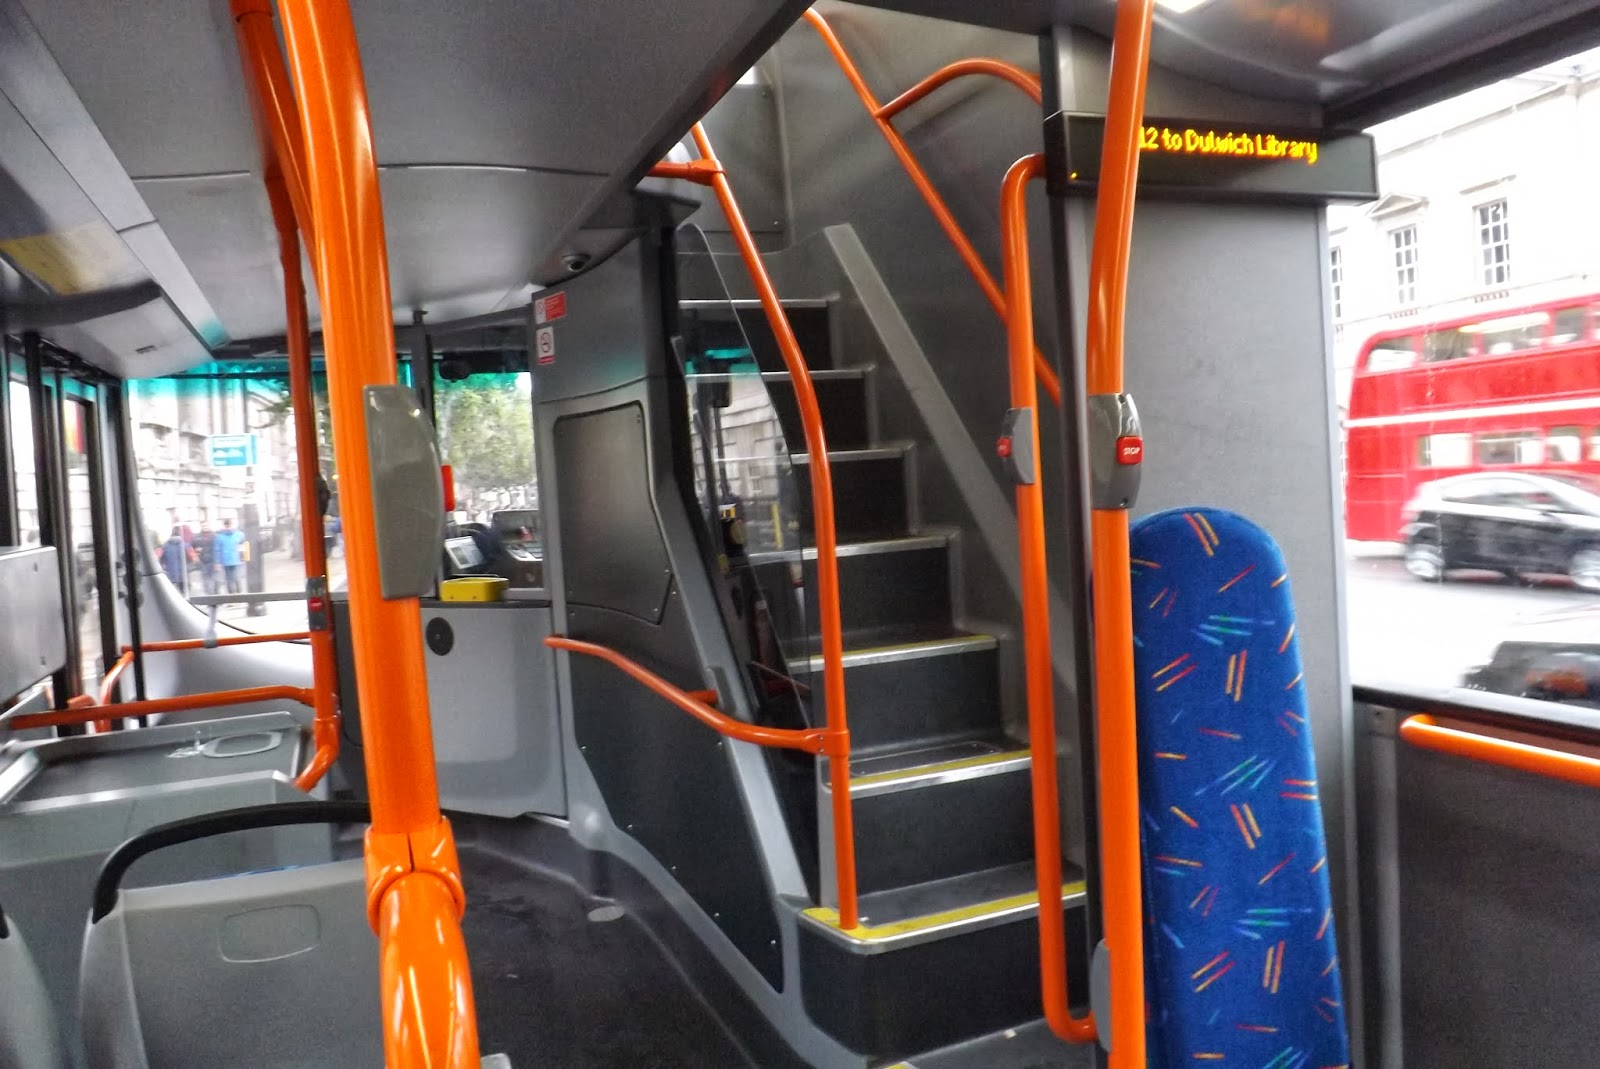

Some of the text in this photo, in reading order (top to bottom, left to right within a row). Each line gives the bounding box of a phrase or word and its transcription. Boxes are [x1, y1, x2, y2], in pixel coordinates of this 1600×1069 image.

[1161, 127, 1182, 150] to
[1185, 129, 1254, 154] Dulwich
[1256, 133, 1317, 163] Library
[1123, 447, 1140, 456] STOP
